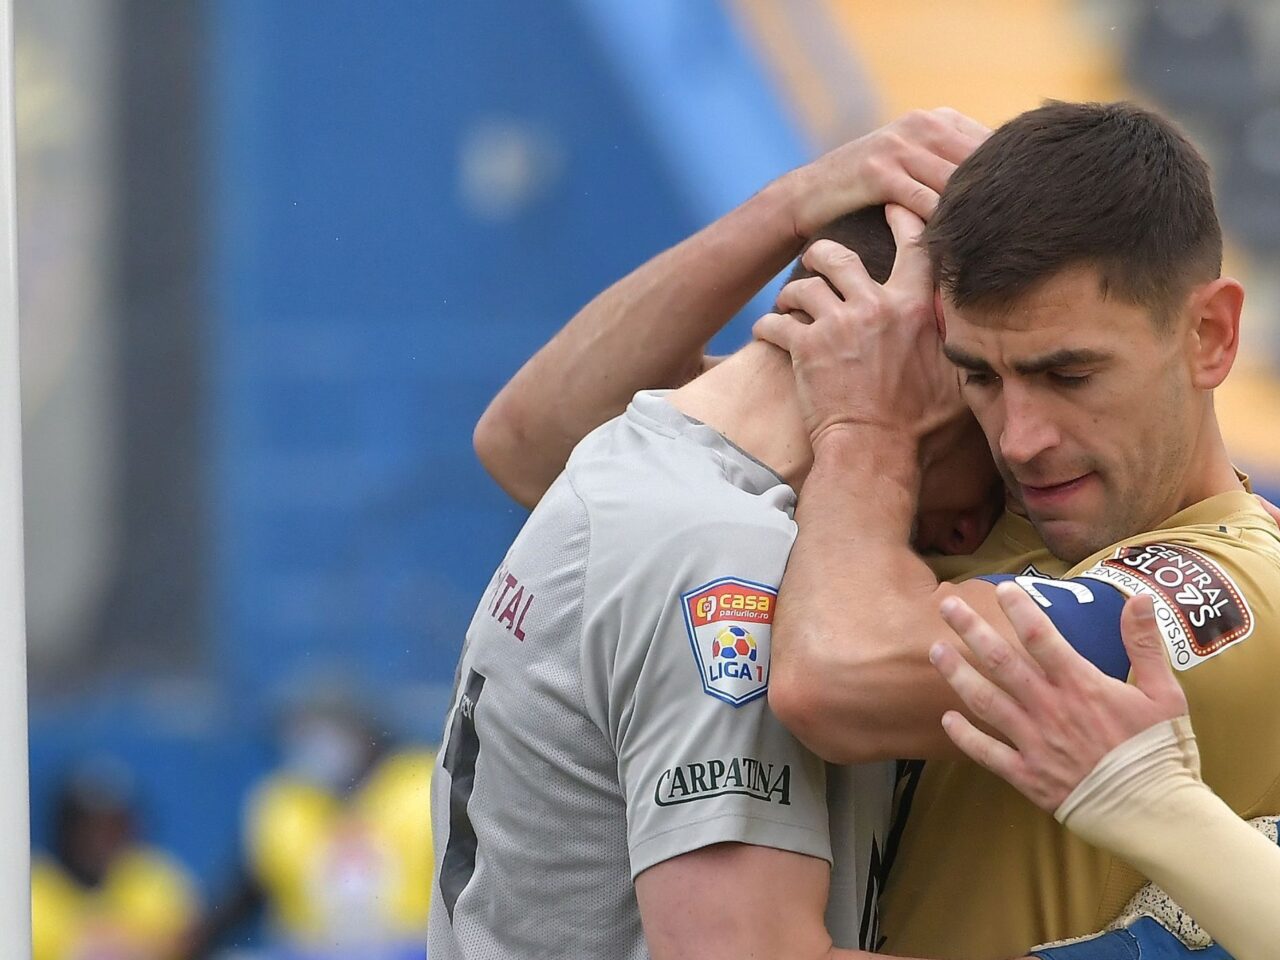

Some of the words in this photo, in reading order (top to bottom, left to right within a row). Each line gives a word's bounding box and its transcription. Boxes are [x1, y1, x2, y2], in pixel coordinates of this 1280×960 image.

[1145, 545, 1229, 617] CENTRAL
[720, 593, 770, 611] casa
[719, 609, 769, 620] pariurilor.ro
[709, 661, 752, 682] LIGA
[756, 665, 763, 683] 1
[654, 757, 792, 806] CARPATINA
